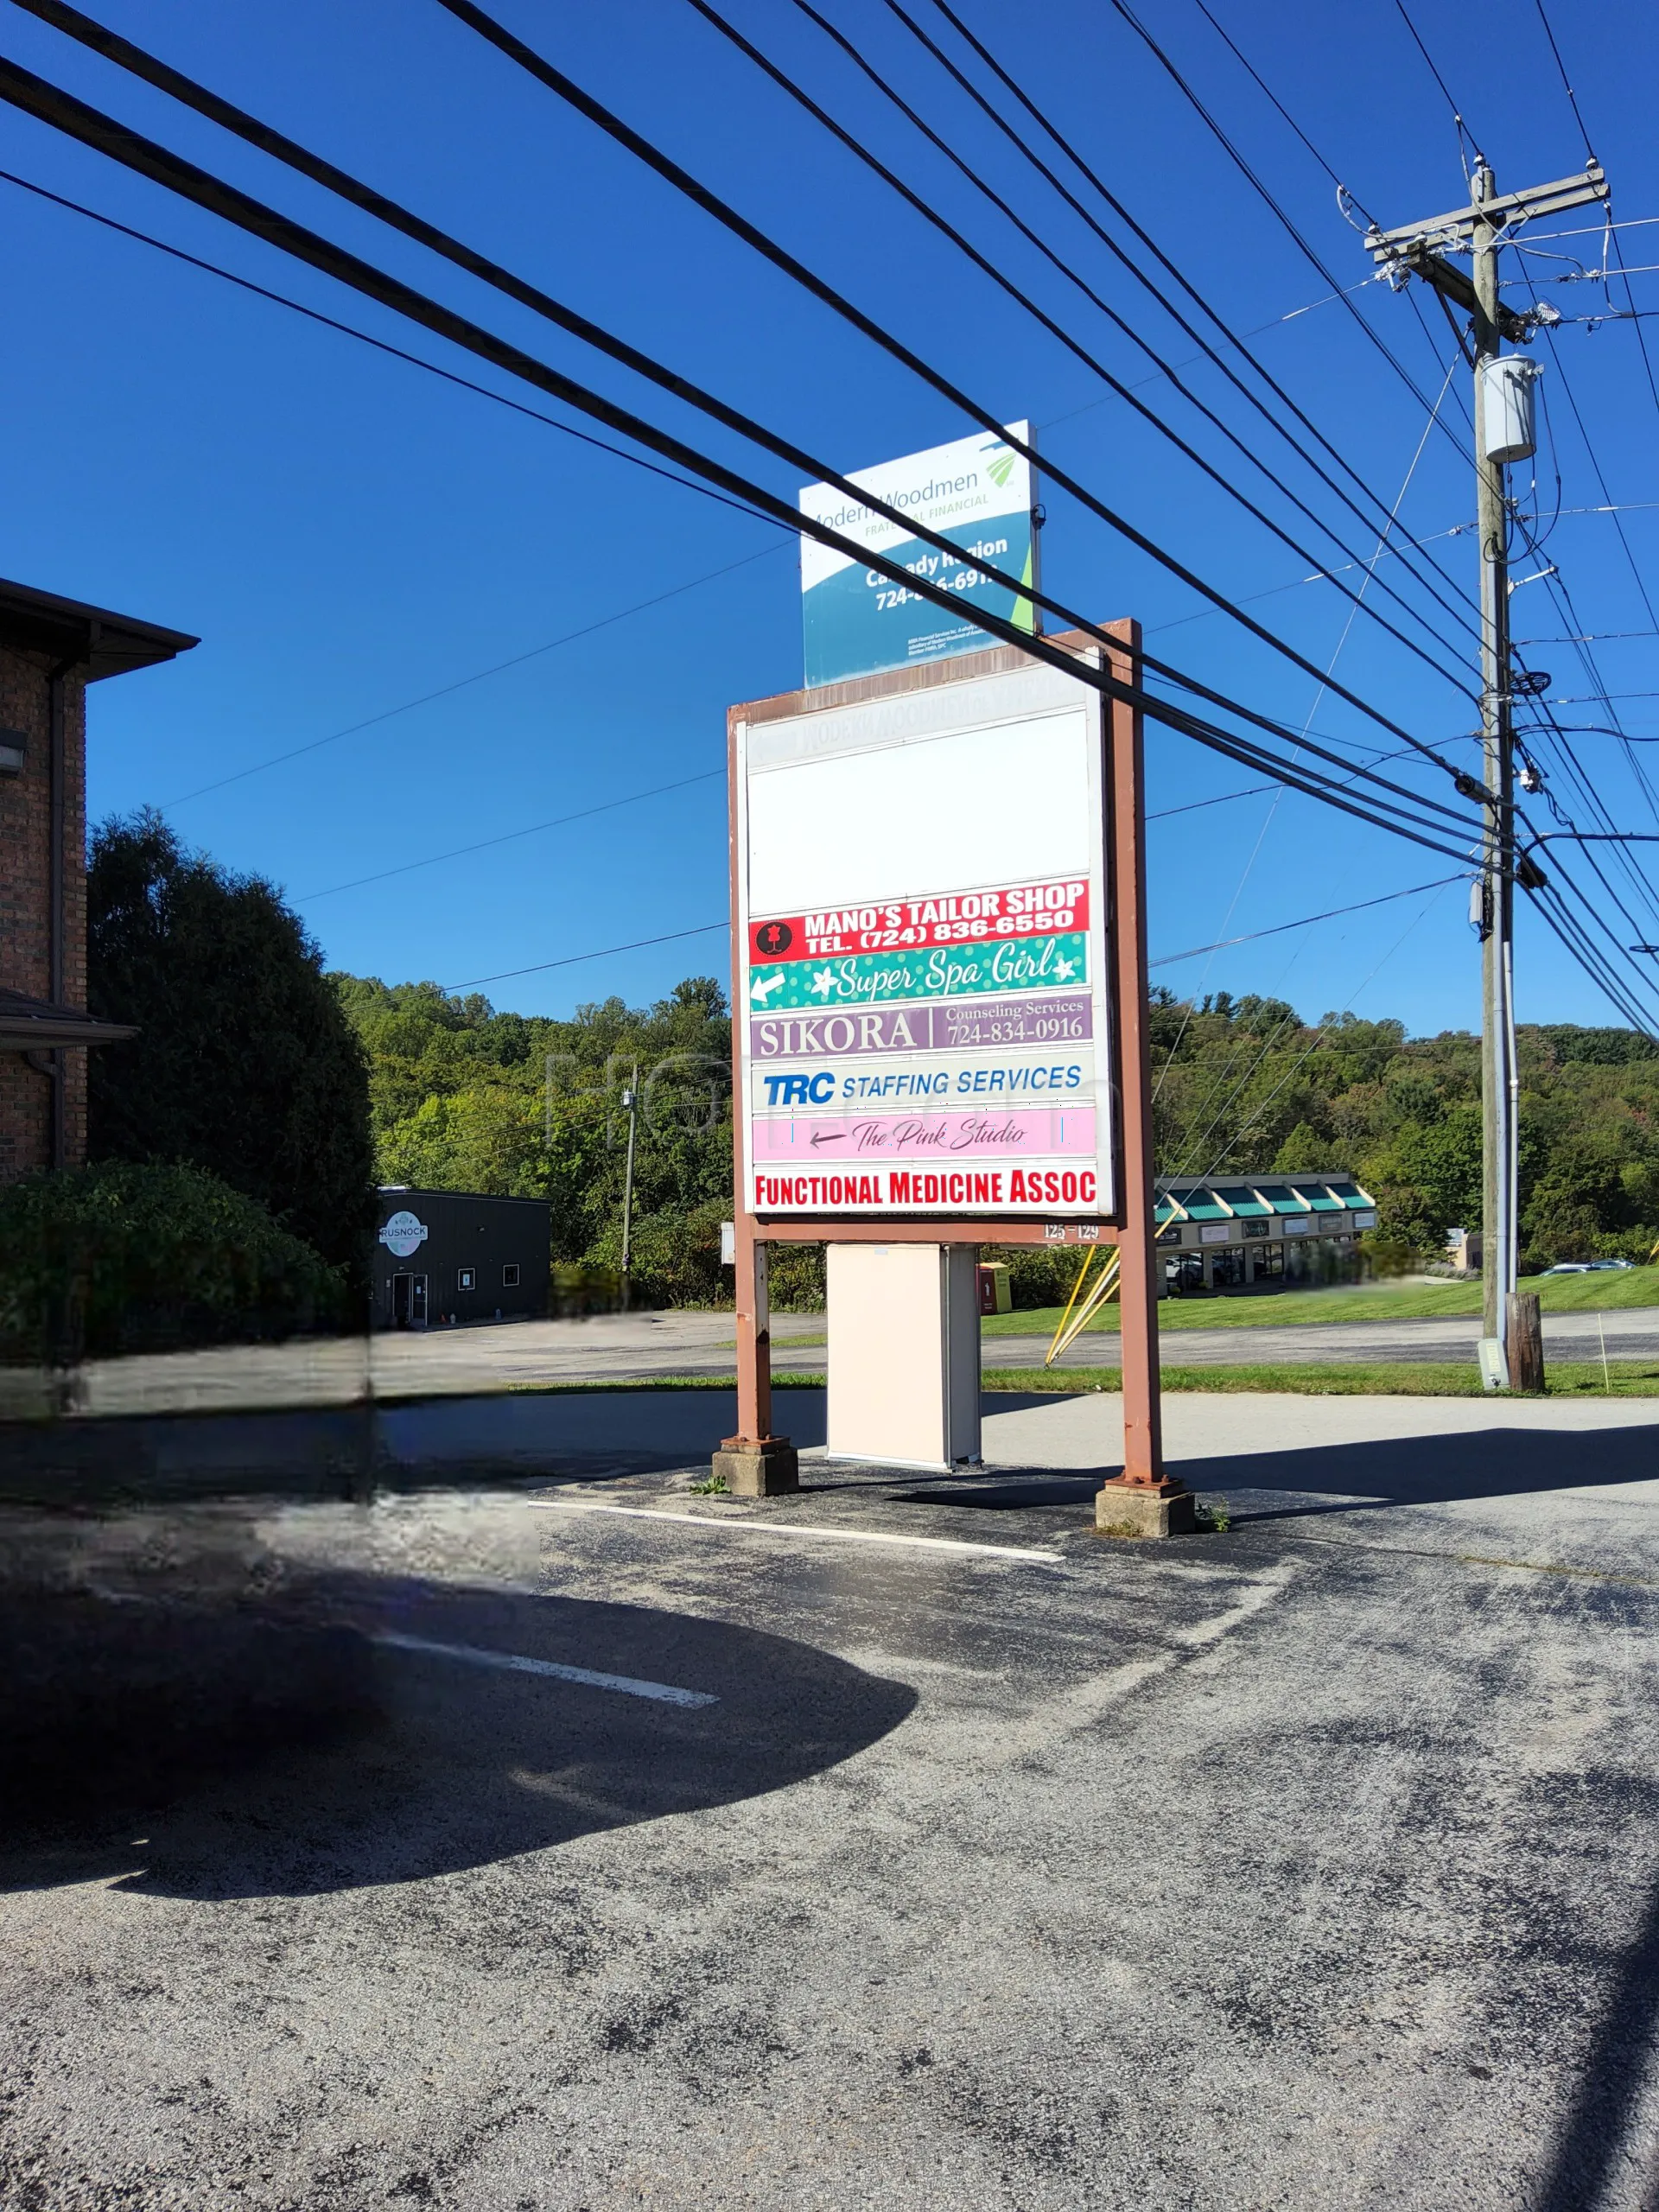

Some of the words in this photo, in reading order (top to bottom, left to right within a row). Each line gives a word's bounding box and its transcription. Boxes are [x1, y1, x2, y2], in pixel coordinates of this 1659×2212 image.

[929, 493, 989, 519] FINANCIAL
[804, 906, 901, 937] MANO'S
[906, 894, 1000, 925] TAILOR
[1006, 882, 1084, 912] SHOP
[805, 935, 852, 954] TEL.
[860, 925, 927, 948] (724)
[934, 910, 1074, 939] 836-6550
[836, 958, 916, 1001] Super
[925, 949, 983, 995] Spa
[992, 938, 1056, 983] Girl
[946, 1003, 1022, 1022] Counseling
[1026, 1000, 1084, 1015] Services
[760, 1012, 917, 1055] SIKORA
[947, 1016, 1084, 1046] 724-834-0916
[763, 1071, 835, 1105] TRC
[842, 1072, 949, 1098] STAFFING
[957, 1065, 1082, 1093] SERVICES
[852, 1122, 886, 1152] The
[893, 1119, 947, 1152] Pink
[950, 1117, 1027, 1151] Studio
[755, 1176, 883, 1205] FUNCTIONAL
[889, 1173, 1002, 1205] MEDICINE
[1010, 1169, 1096, 1203] ASSOC
[381, 1227, 426, 1237] RUSNOCK
